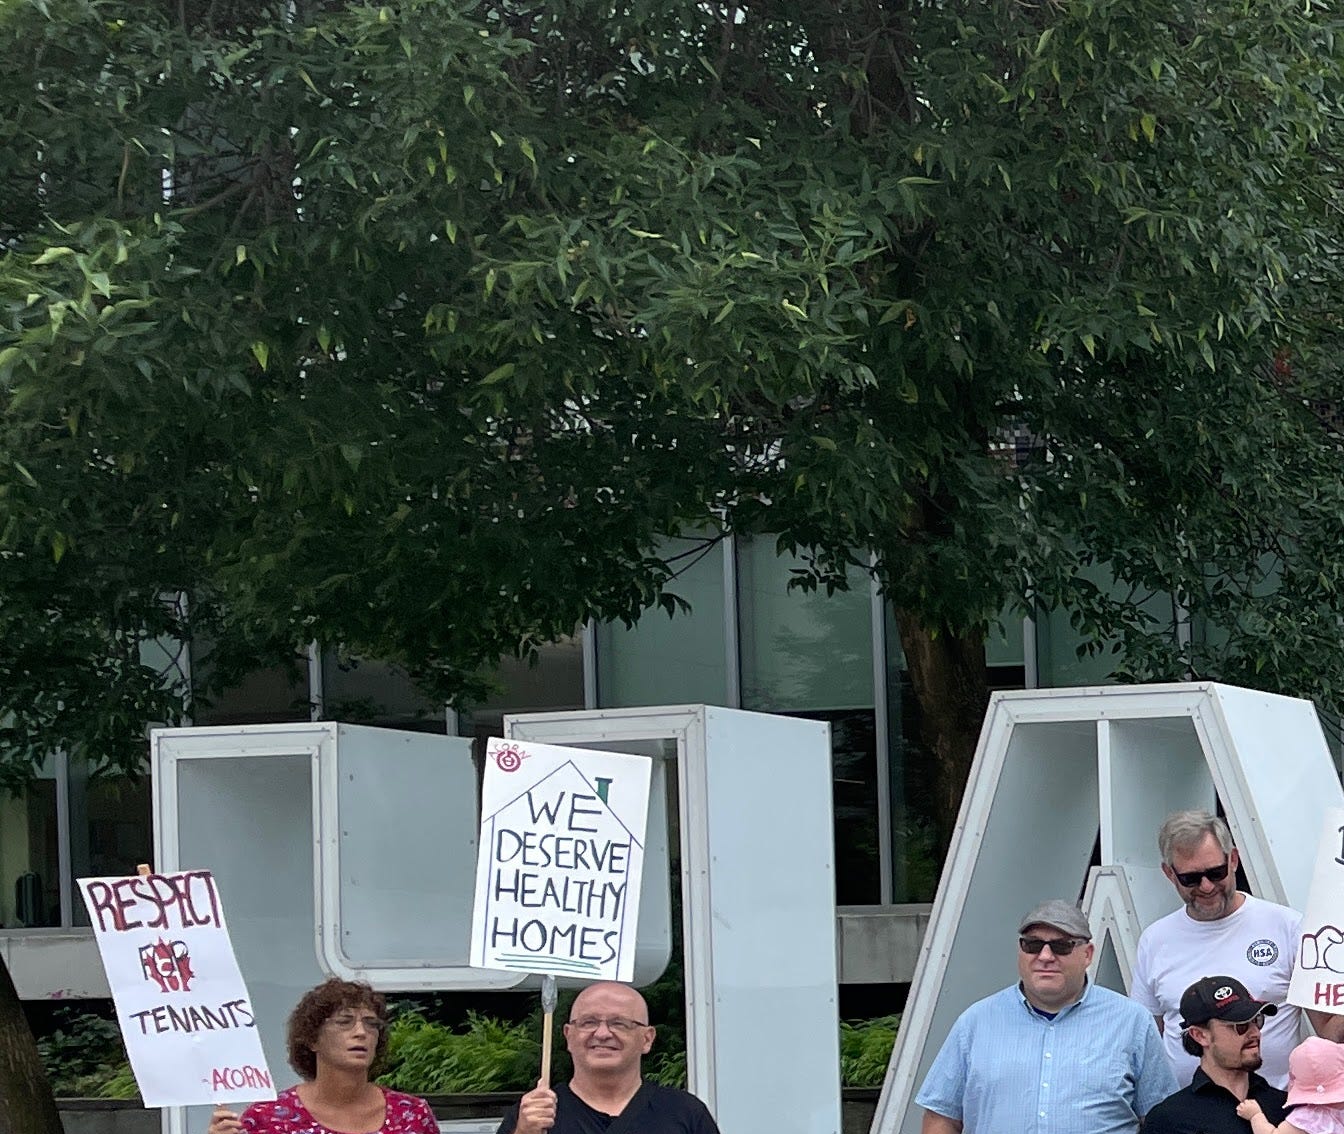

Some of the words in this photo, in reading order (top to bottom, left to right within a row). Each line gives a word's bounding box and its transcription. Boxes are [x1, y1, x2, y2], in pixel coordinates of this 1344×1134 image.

[527, 791, 602, 832] WE
[496, 829, 630, 874] DESERVE
[87, 871, 221, 932] RESPECT
[495, 868, 627, 922] HEALTHY
[492, 917, 618, 964] HOMES
[1253, 948, 1272, 958] HSA
[129, 999, 256, 1035] TENANTS
